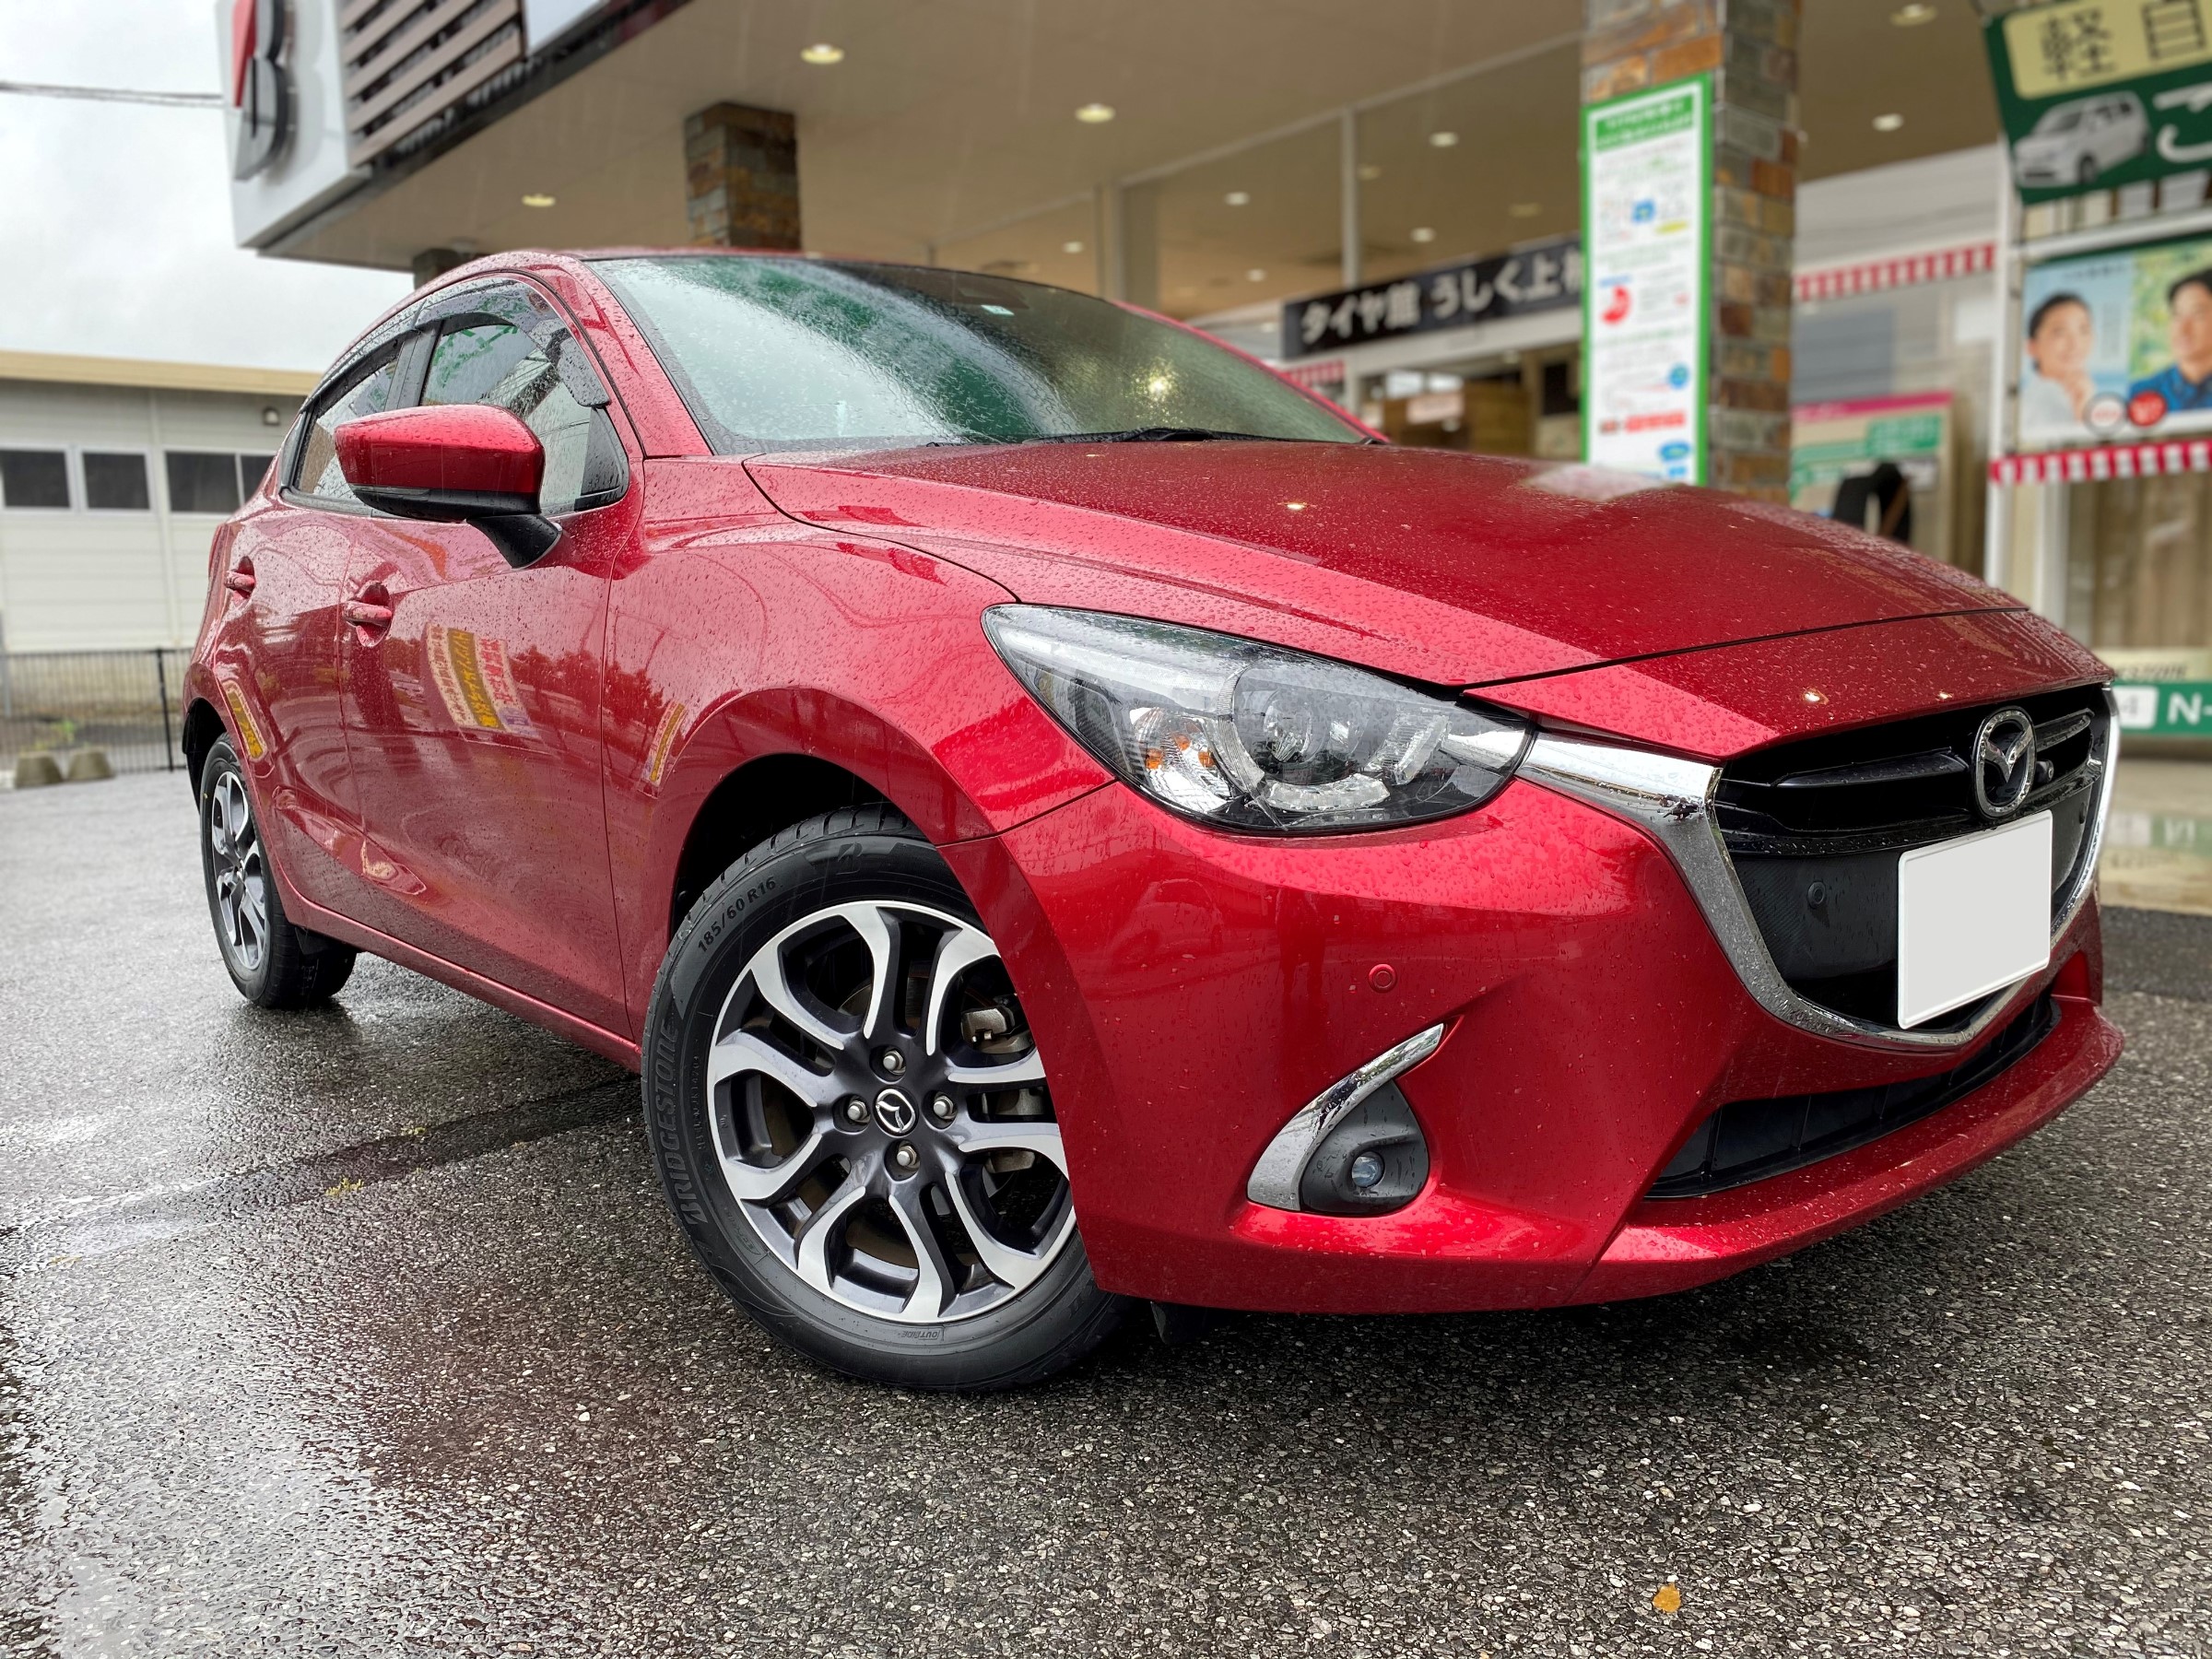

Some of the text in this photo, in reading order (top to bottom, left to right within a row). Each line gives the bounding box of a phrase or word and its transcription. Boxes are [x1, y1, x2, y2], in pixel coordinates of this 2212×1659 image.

[1301, 281, 1421, 345] タイヤ館
[654, 1019, 709, 1225] BRIDGESTONE
